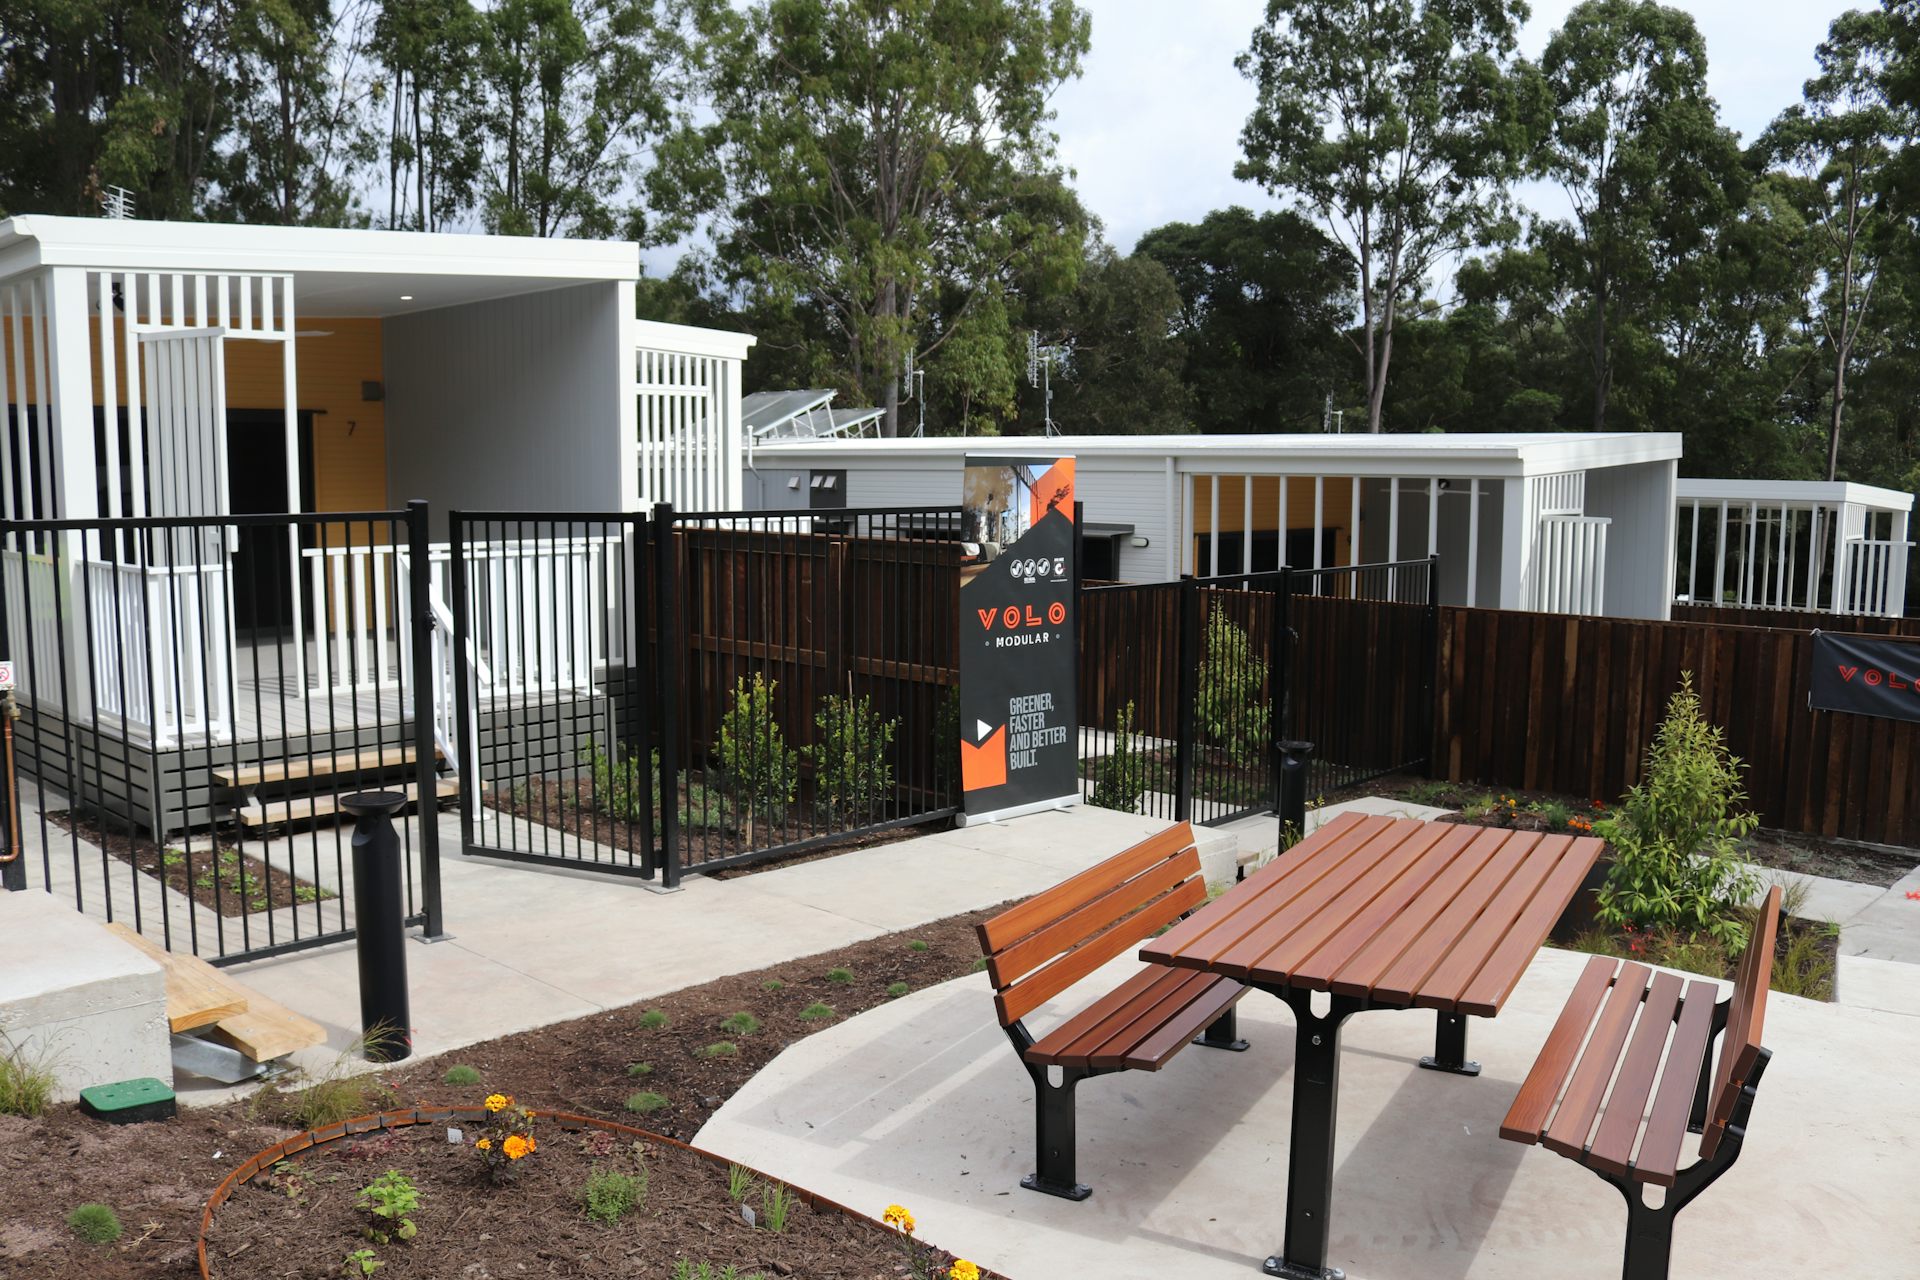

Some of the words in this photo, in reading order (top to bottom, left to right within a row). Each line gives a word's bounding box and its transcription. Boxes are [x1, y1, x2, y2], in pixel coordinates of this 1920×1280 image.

[347, 420, 357, 437] 7
[977, 602, 1066, 631] VOLO
[996, 632, 1050, 648] MODULAR
[1009, 692, 1055, 716] GREENER,
[1009, 712, 1045, 734] FASTER
[1009, 732, 1031, 752] AND
[1032, 725, 1067, 749] BETTER
[1009, 749, 1038, 771] BUILT.
